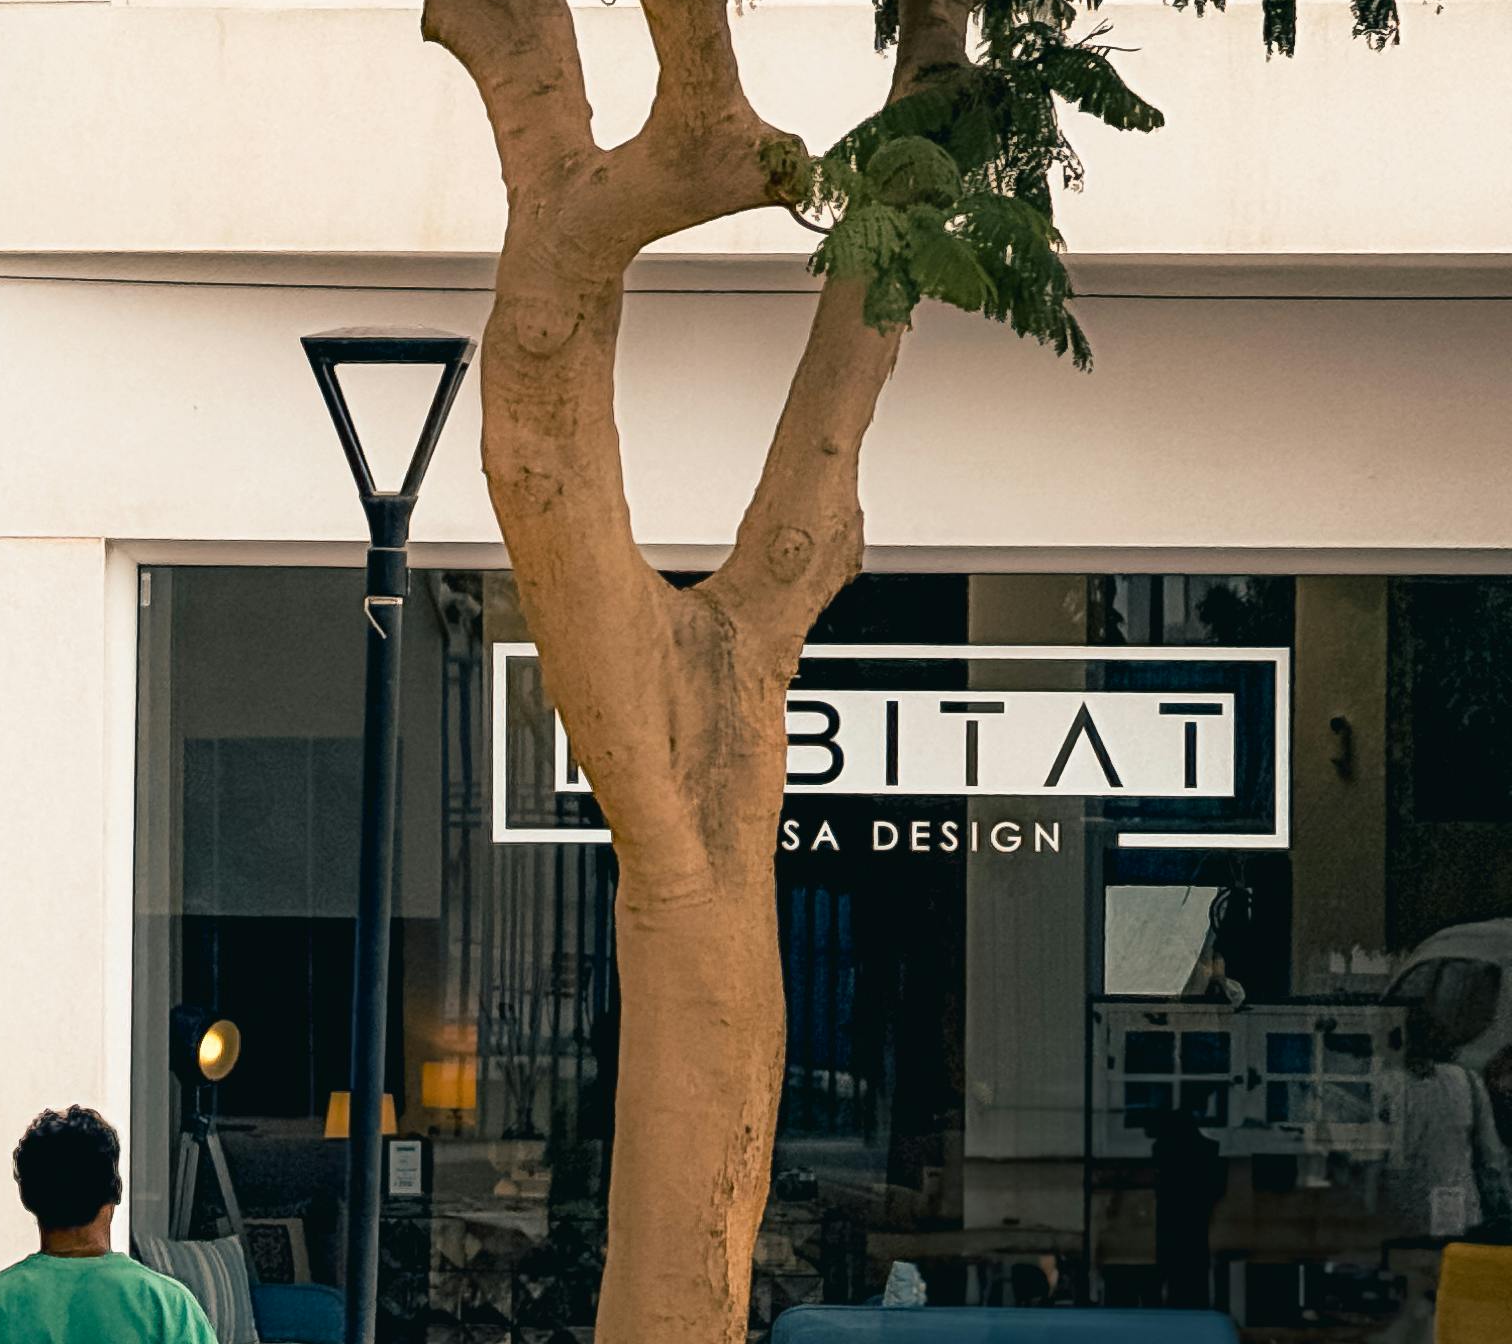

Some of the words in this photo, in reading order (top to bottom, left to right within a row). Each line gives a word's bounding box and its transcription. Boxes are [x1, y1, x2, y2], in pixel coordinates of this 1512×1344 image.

[567, 699, 1224, 789] BITAT
[781, 819, 841, 853] SA
[872, 820, 1060, 853] DESIGN
